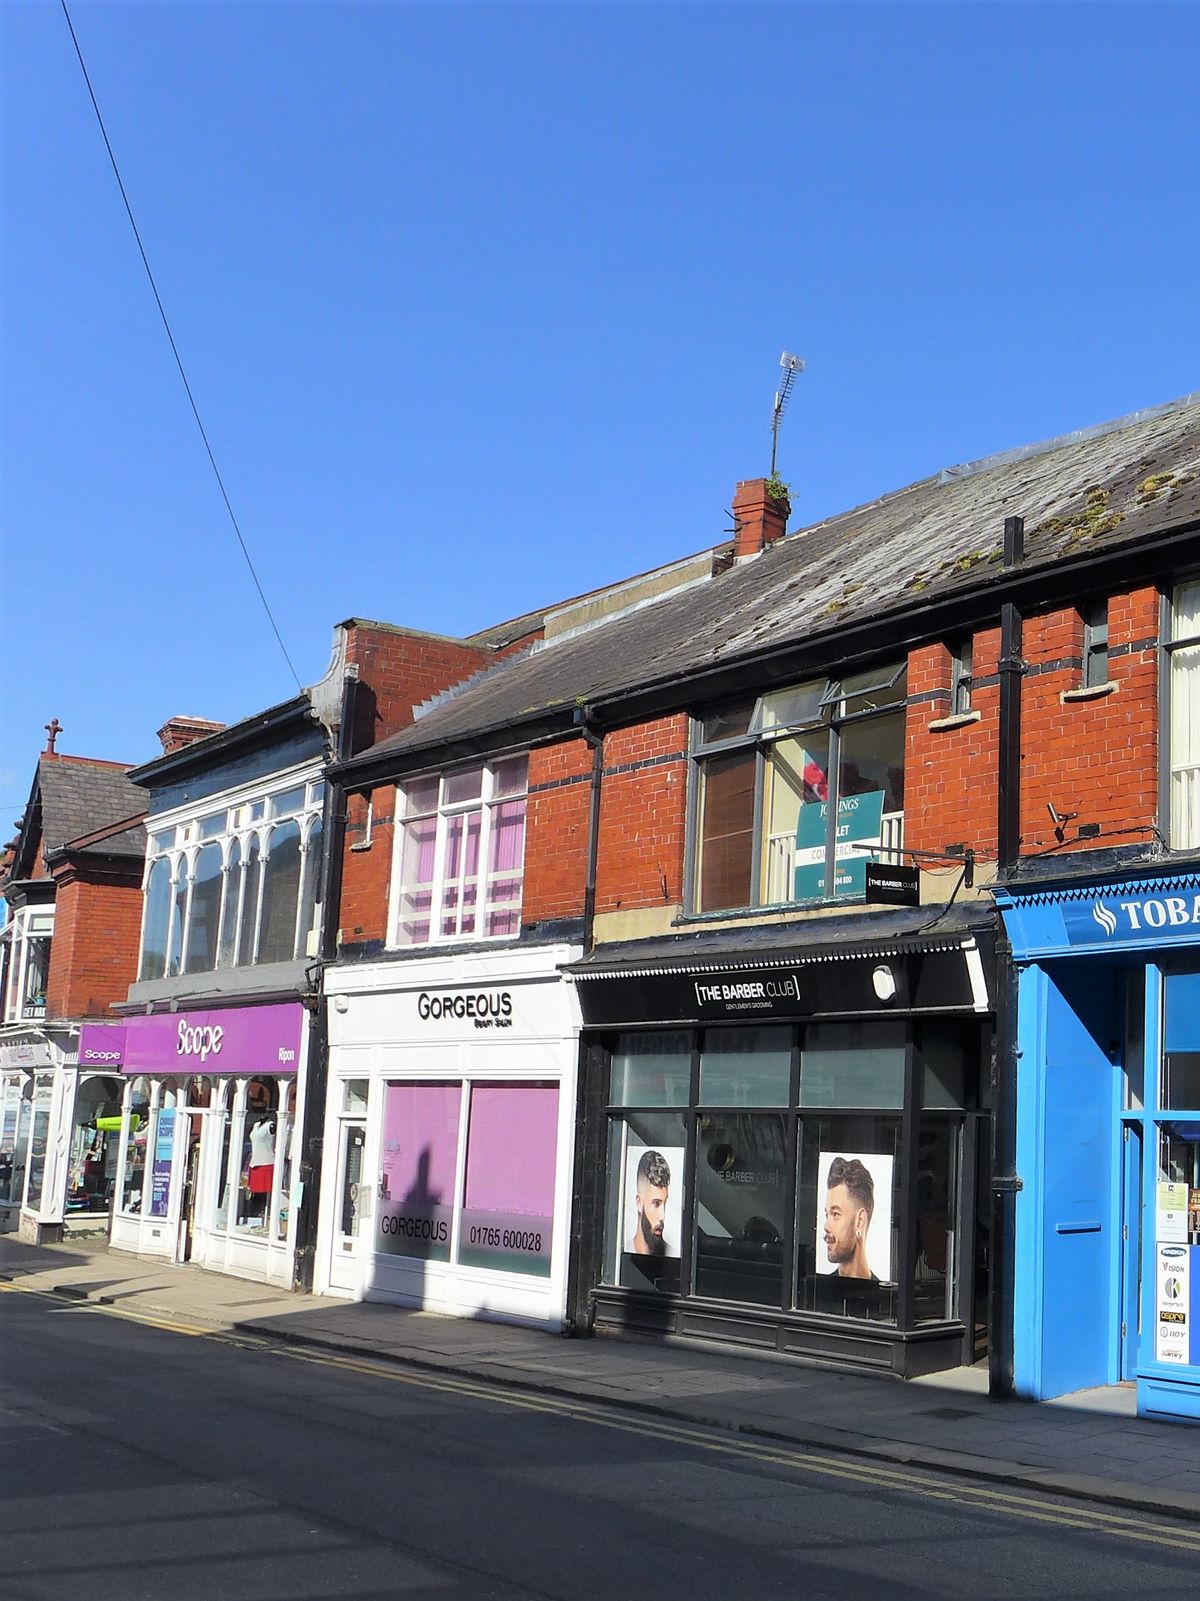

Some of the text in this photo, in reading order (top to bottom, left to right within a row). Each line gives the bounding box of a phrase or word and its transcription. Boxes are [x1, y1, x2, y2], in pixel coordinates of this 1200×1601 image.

[722, 983, 765, 1000] BARBER
[418, 992, 512, 1020] GORGEOUS
[177, 1019, 223, 1062] Scope
[85, 1050, 120, 1061] Scope
[279, 1047, 294, 1063] Ripon
[726, 1171, 754, 1182] BARBER
[382, 1216, 447, 1241] GORGEOUS
[470, 1226, 541, 1251] 01765 600028
